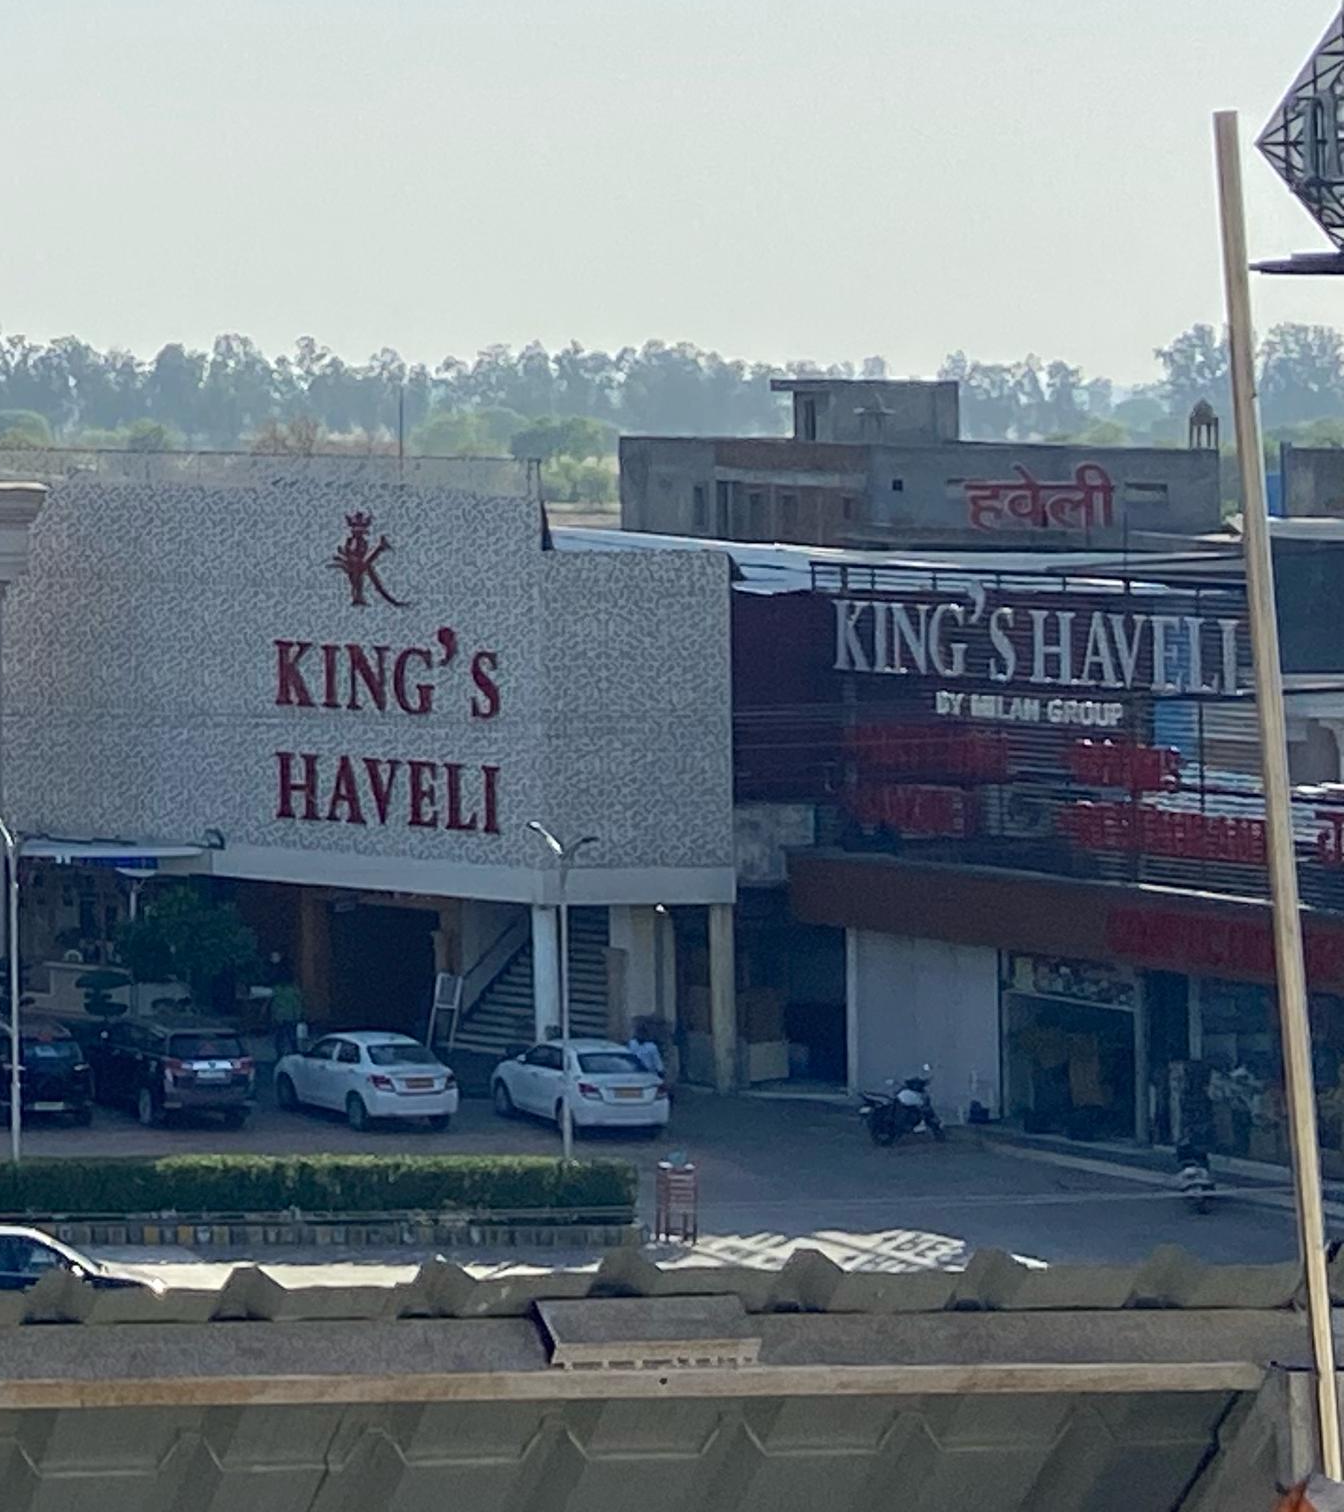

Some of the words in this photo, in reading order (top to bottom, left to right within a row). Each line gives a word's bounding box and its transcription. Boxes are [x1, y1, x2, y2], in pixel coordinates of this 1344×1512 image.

[964, 462, 1115, 532] हवेली
[273, 626, 501, 719] KING'S
[833, 580, 1017, 682] KING'S
[1028, 610, 1242, 696] HAVELI
[936, 690, 964, 716] BY
[970, 693, 1040, 723] MILAN
[1047, 699, 1124, 727] GROUP
[275, 751, 501, 835] HAVELI
